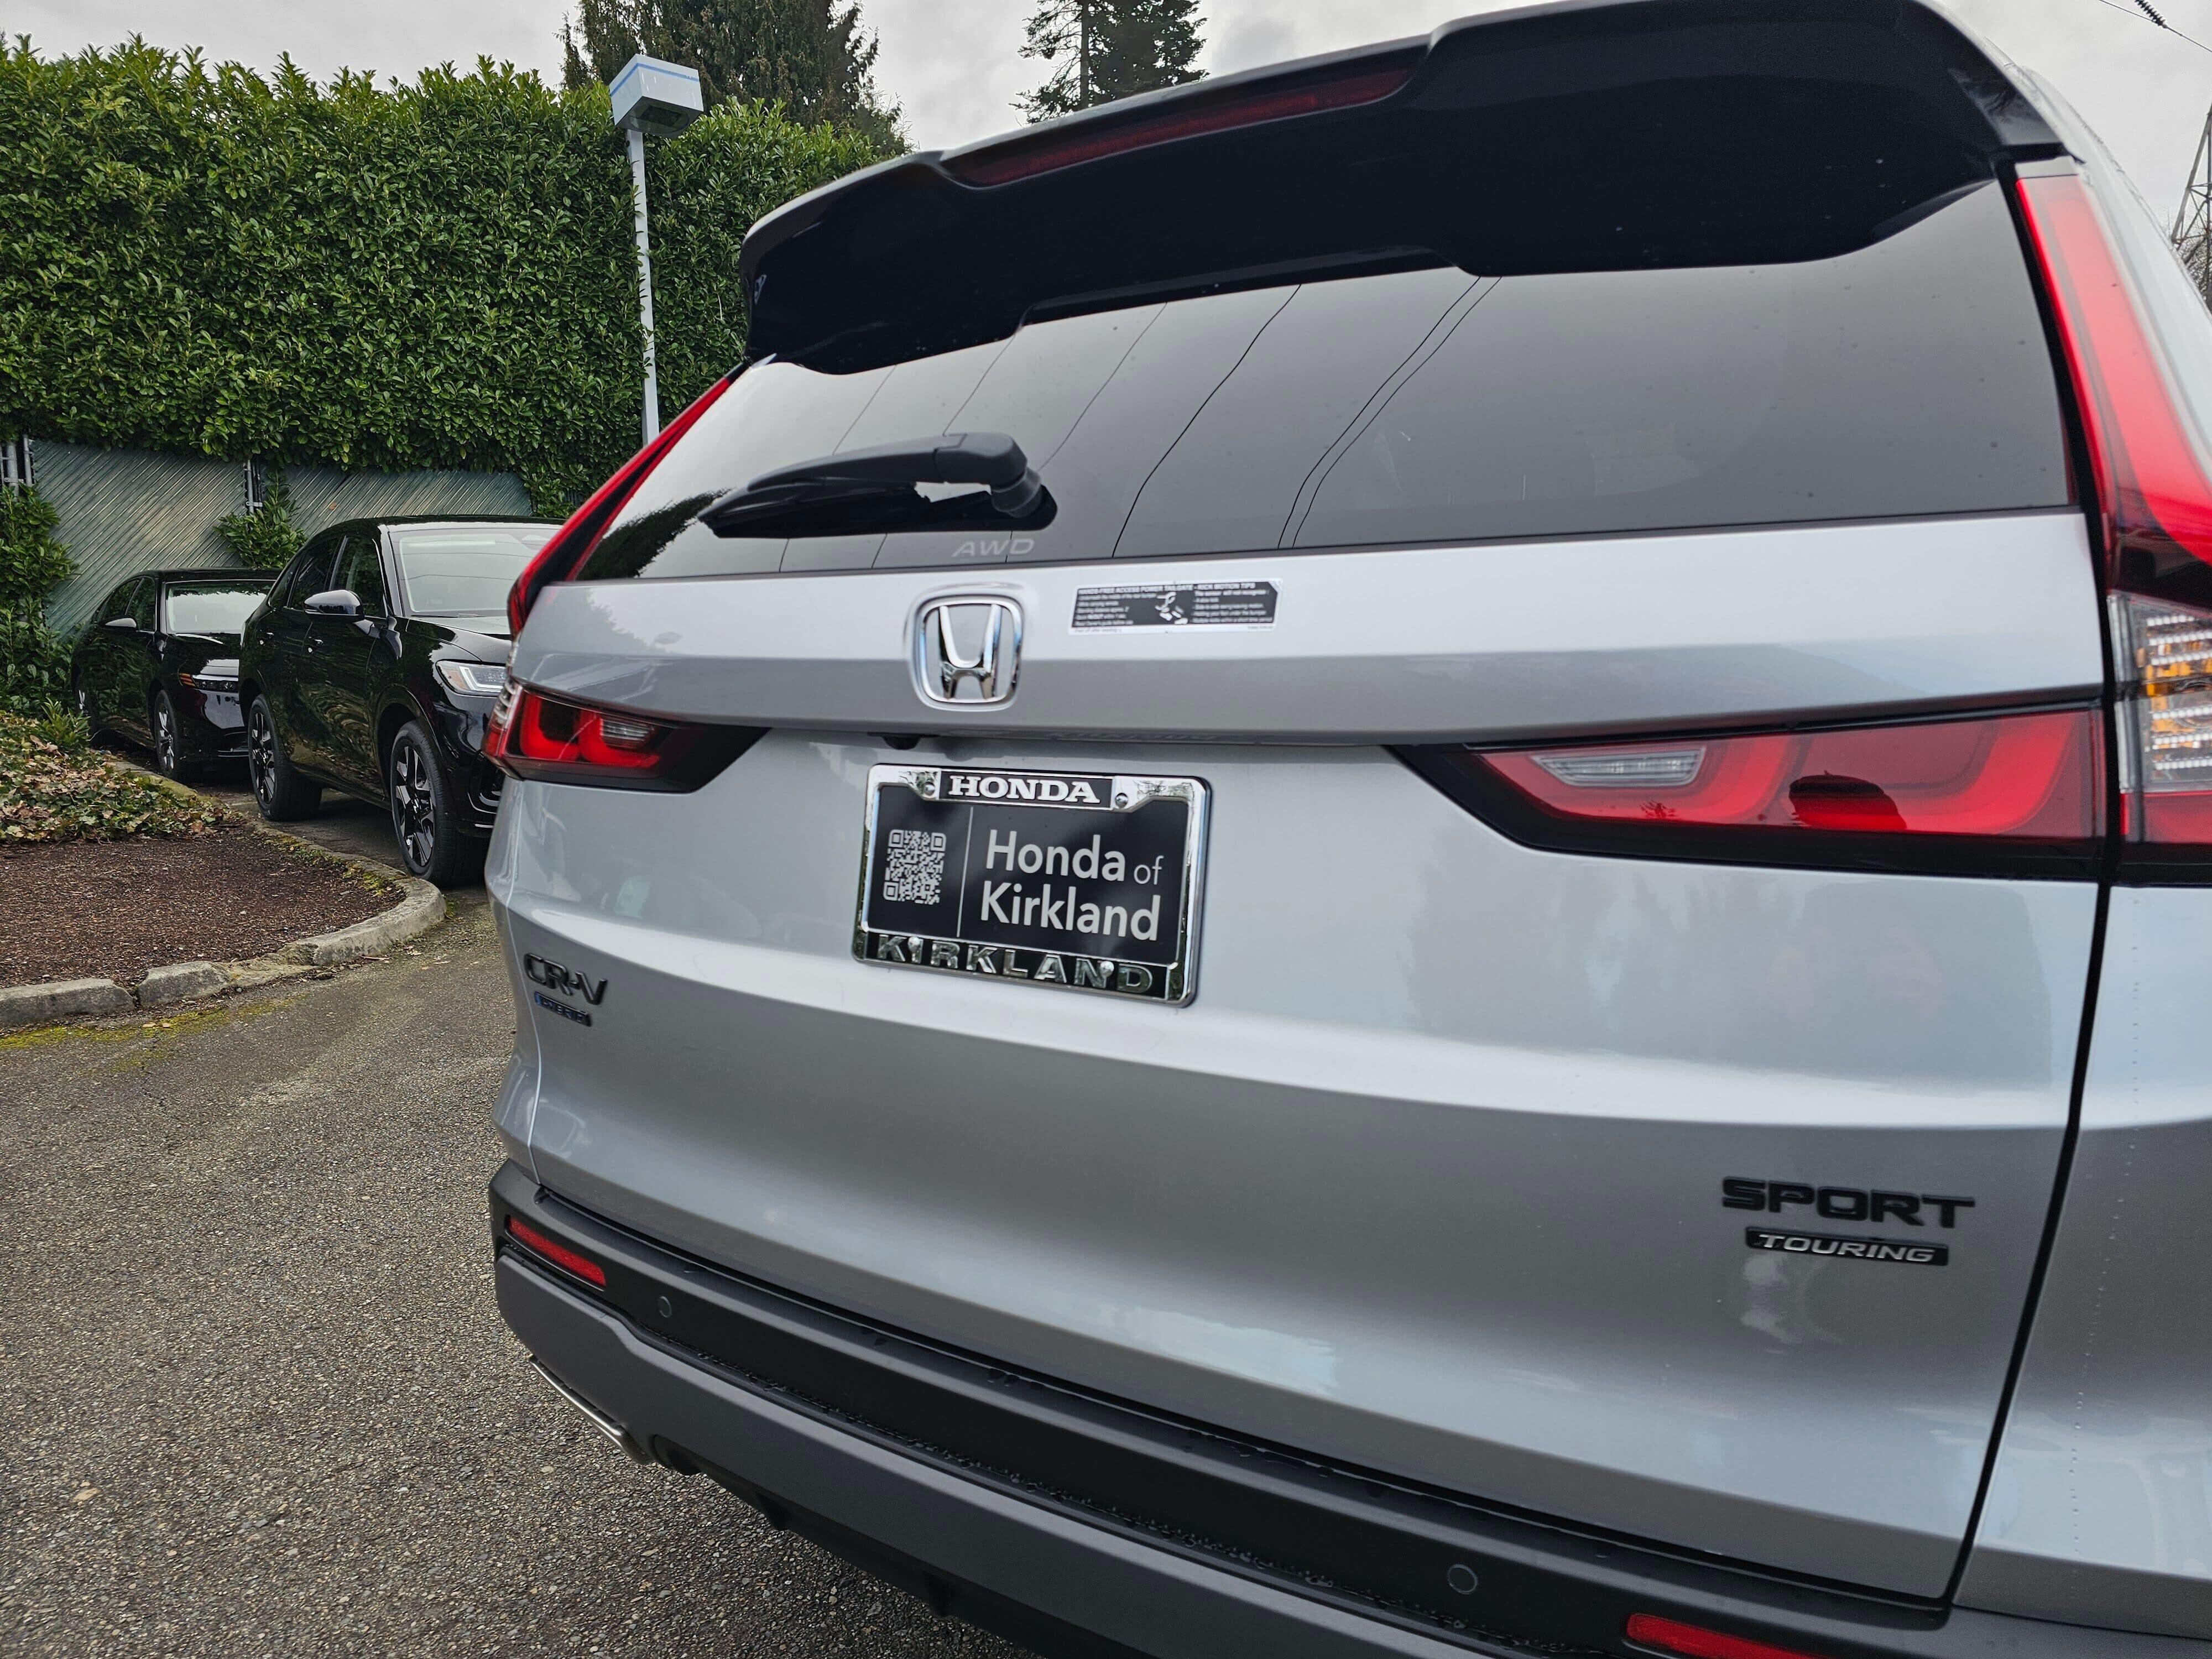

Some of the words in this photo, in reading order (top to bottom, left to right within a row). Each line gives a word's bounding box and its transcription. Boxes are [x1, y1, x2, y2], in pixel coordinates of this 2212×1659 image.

[951, 538, 1035, 557] AWD
[949, 775, 1100, 804] HONDA
[985, 829, 1126, 882] Honda
[1133, 855, 1164, 885] of
[980, 880, 1161, 941] Kirkland
[524, 953, 608, 1005] CR-V
[877, 935, 1152, 993] KIRKLAND
[1722, 1176, 1976, 1229] SPORT
[1758, 1233, 1936, 1262] TOURING
